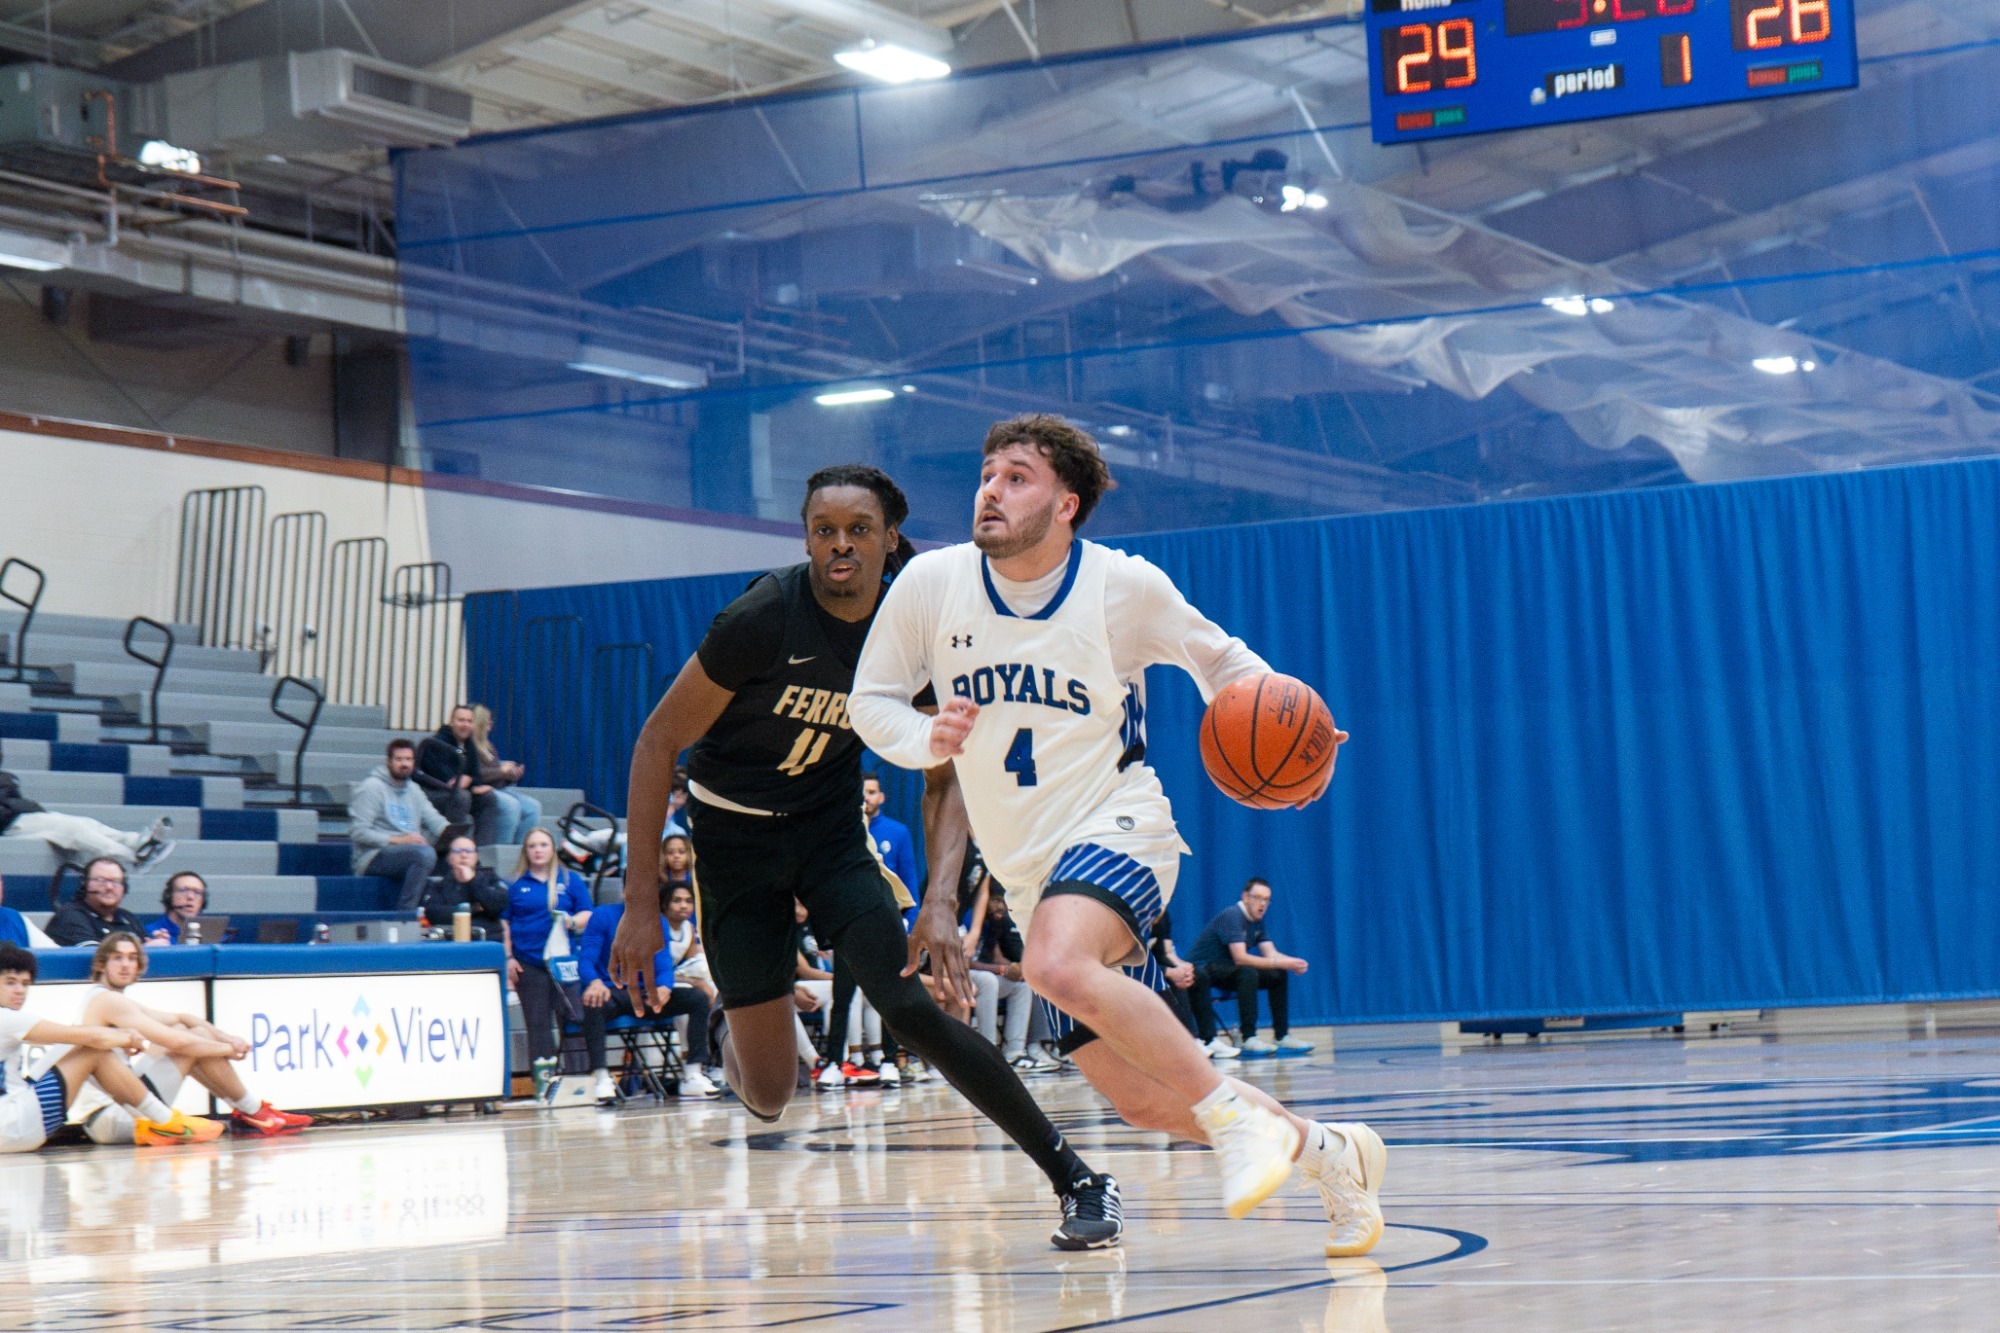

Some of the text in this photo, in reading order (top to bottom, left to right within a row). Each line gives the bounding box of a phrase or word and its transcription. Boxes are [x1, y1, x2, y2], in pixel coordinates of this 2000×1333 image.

[1746, 0, 1830, 49] 26
[1398, 18, 1476, 92] 29
[1680, 35, 1692, 83] 1
[1554, 63, 1615, 98] period
[776, 728, 832, 776] 11
[1004, 727, 1037, 787] 4
[252, 1006, 480, 1072] Park View
